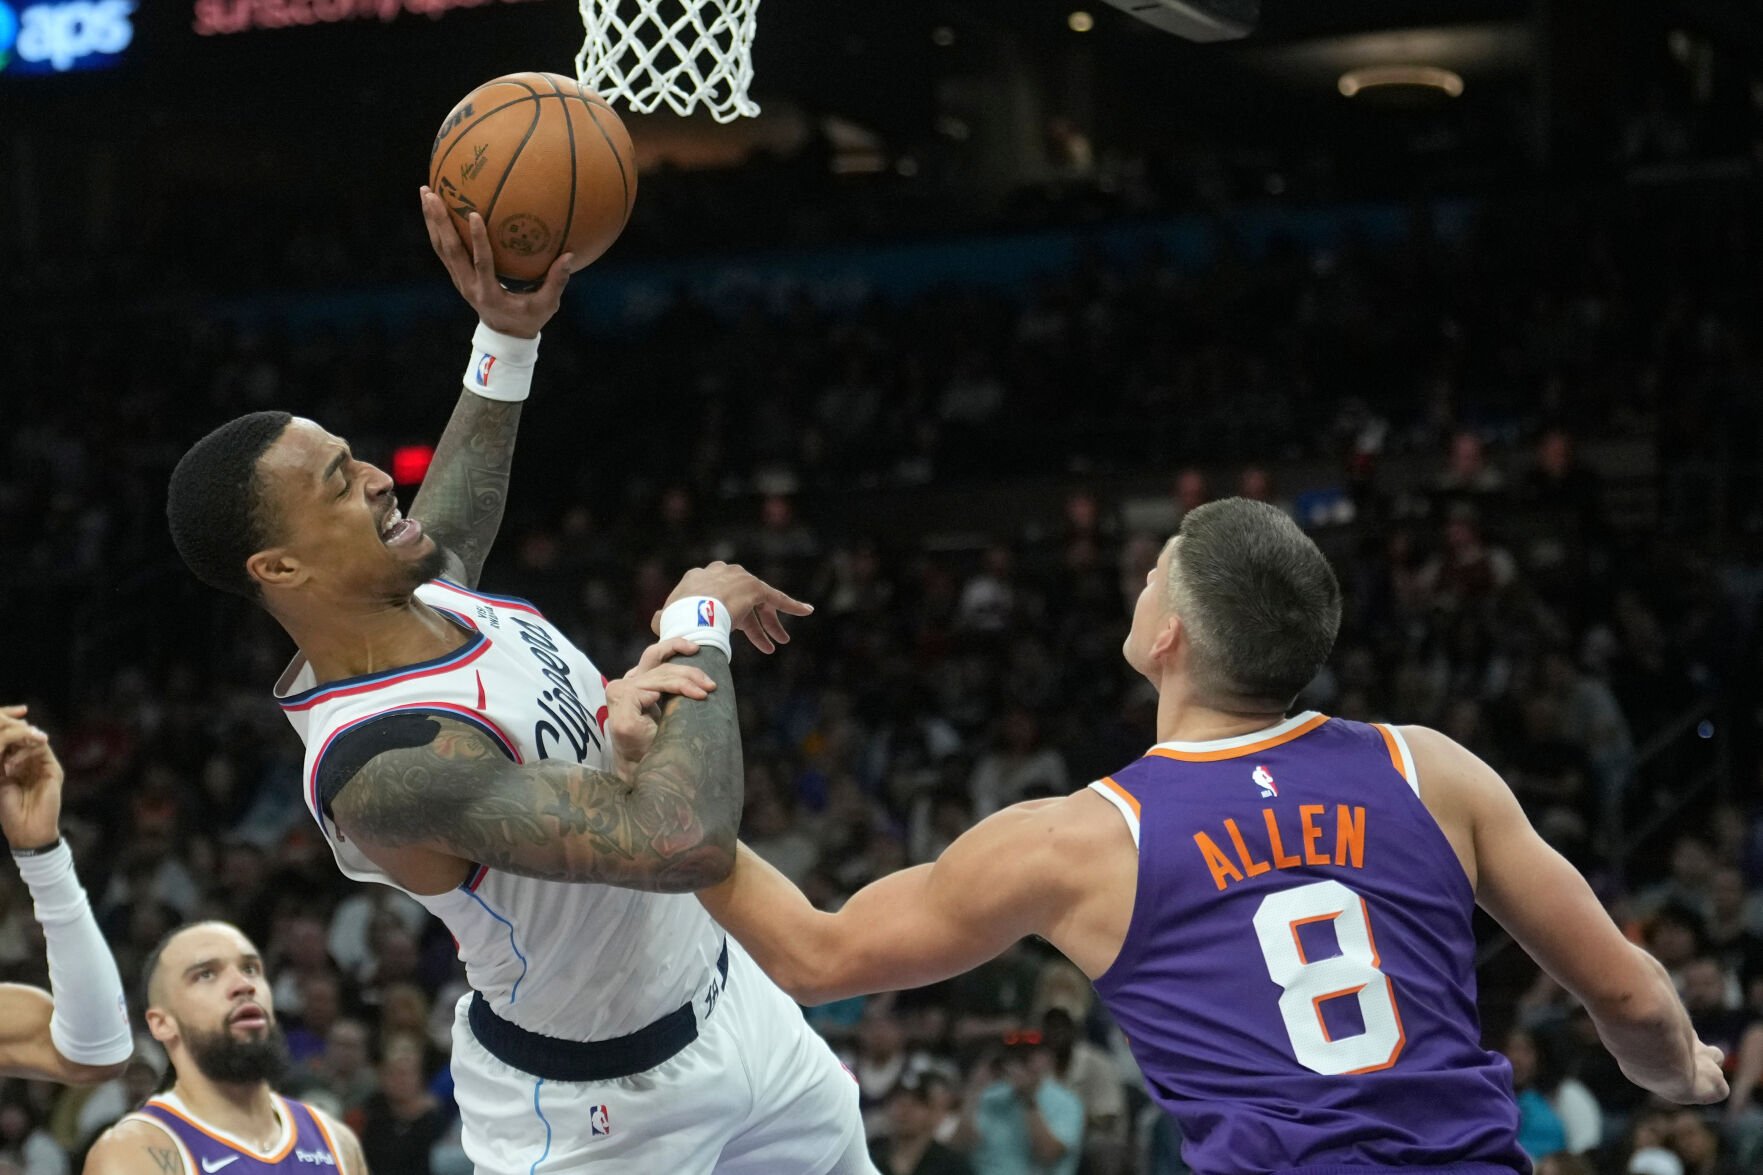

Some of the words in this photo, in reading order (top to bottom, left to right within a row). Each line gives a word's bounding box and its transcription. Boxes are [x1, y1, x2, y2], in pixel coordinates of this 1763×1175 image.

[17, 0, 138, 71] aps
[1193, 804, 1366, 891] ALLEN
[1252, 879, 1406, 1076] 8
